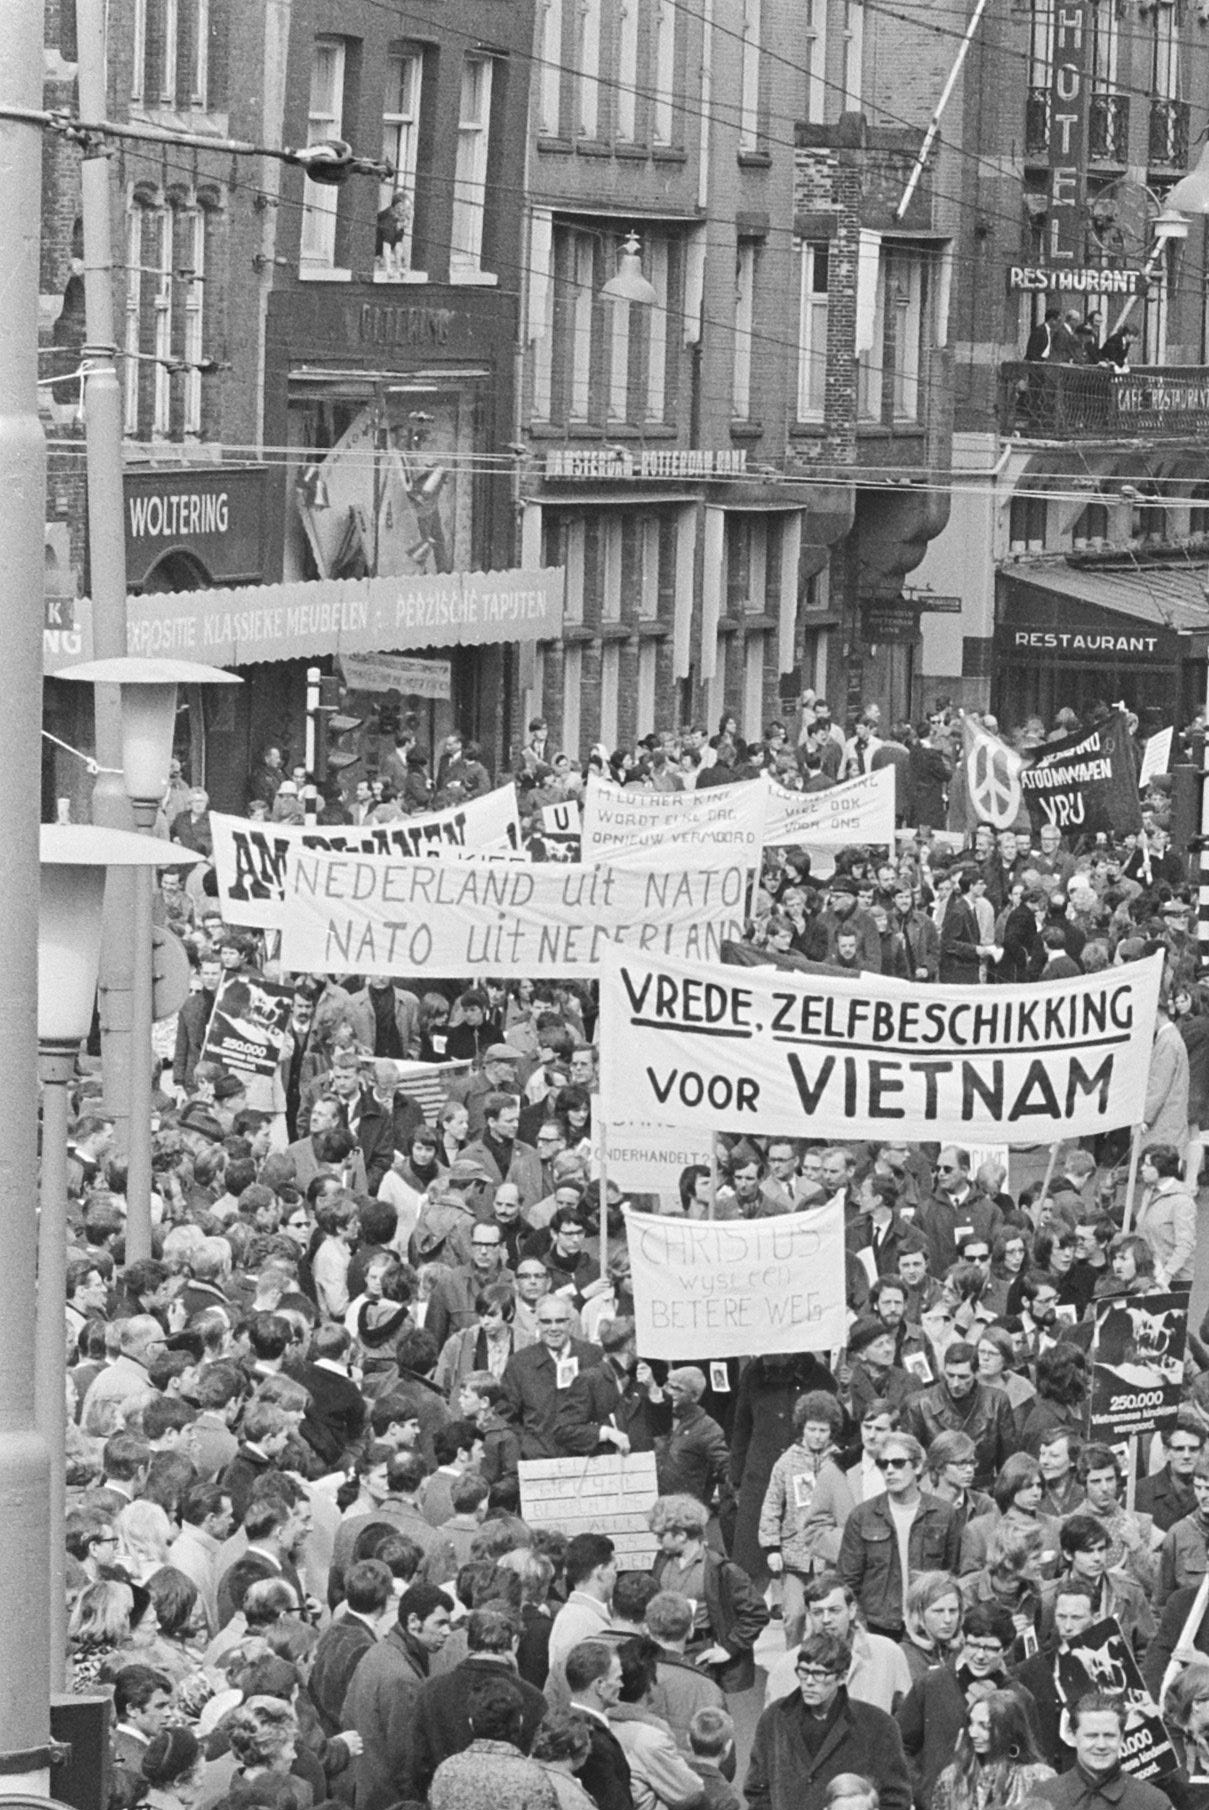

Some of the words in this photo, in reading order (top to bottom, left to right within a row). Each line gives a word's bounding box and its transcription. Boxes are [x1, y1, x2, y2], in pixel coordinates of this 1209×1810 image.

[1051, 9, 1083, 258] HOTEL
[1010, 266, 1140, 293] RESTAURANT
[130, 492, 229, 538] WOLTERING
[202, 607, 283, 646] KLASSIEKE
[286, 600, 367, 637] MEUBELEN
[396, 589, 477, 627] PERZISCHE
[1014, 632, 1159, 652] RESTAURANT
[553, 805, 570, 831] U
[597, 807, 660, 827] WORDT
[831, 817, 861, 830] ONS
[592, 831, 664, 847] OPNIEUW
[671, 830, 756, 846] VERMOORD
[294, 859, 534, 907] NEDERLAND
[561, 863, 615, 907] uit
[644, 866, 742, 908] NATO
[325, 918, 434, 965] NATO
[771, 984, 1135, 1046] ZELFBESCHIKKING
[645, 1066, 762, 1113] VOOR
[786, 1051, 1116, 1122] VIETNAM
[641, 1222, 822, 1266] CHRISTUS
[748, 1266, 792, 1288] een
[651, 1298, 754, 1329] BETERE
[764, 1291, 823, 1325] WEG
[1108, 1390, 1164, 1411] 250.000
[1118, 1727, 1154, 1759] 0.000
